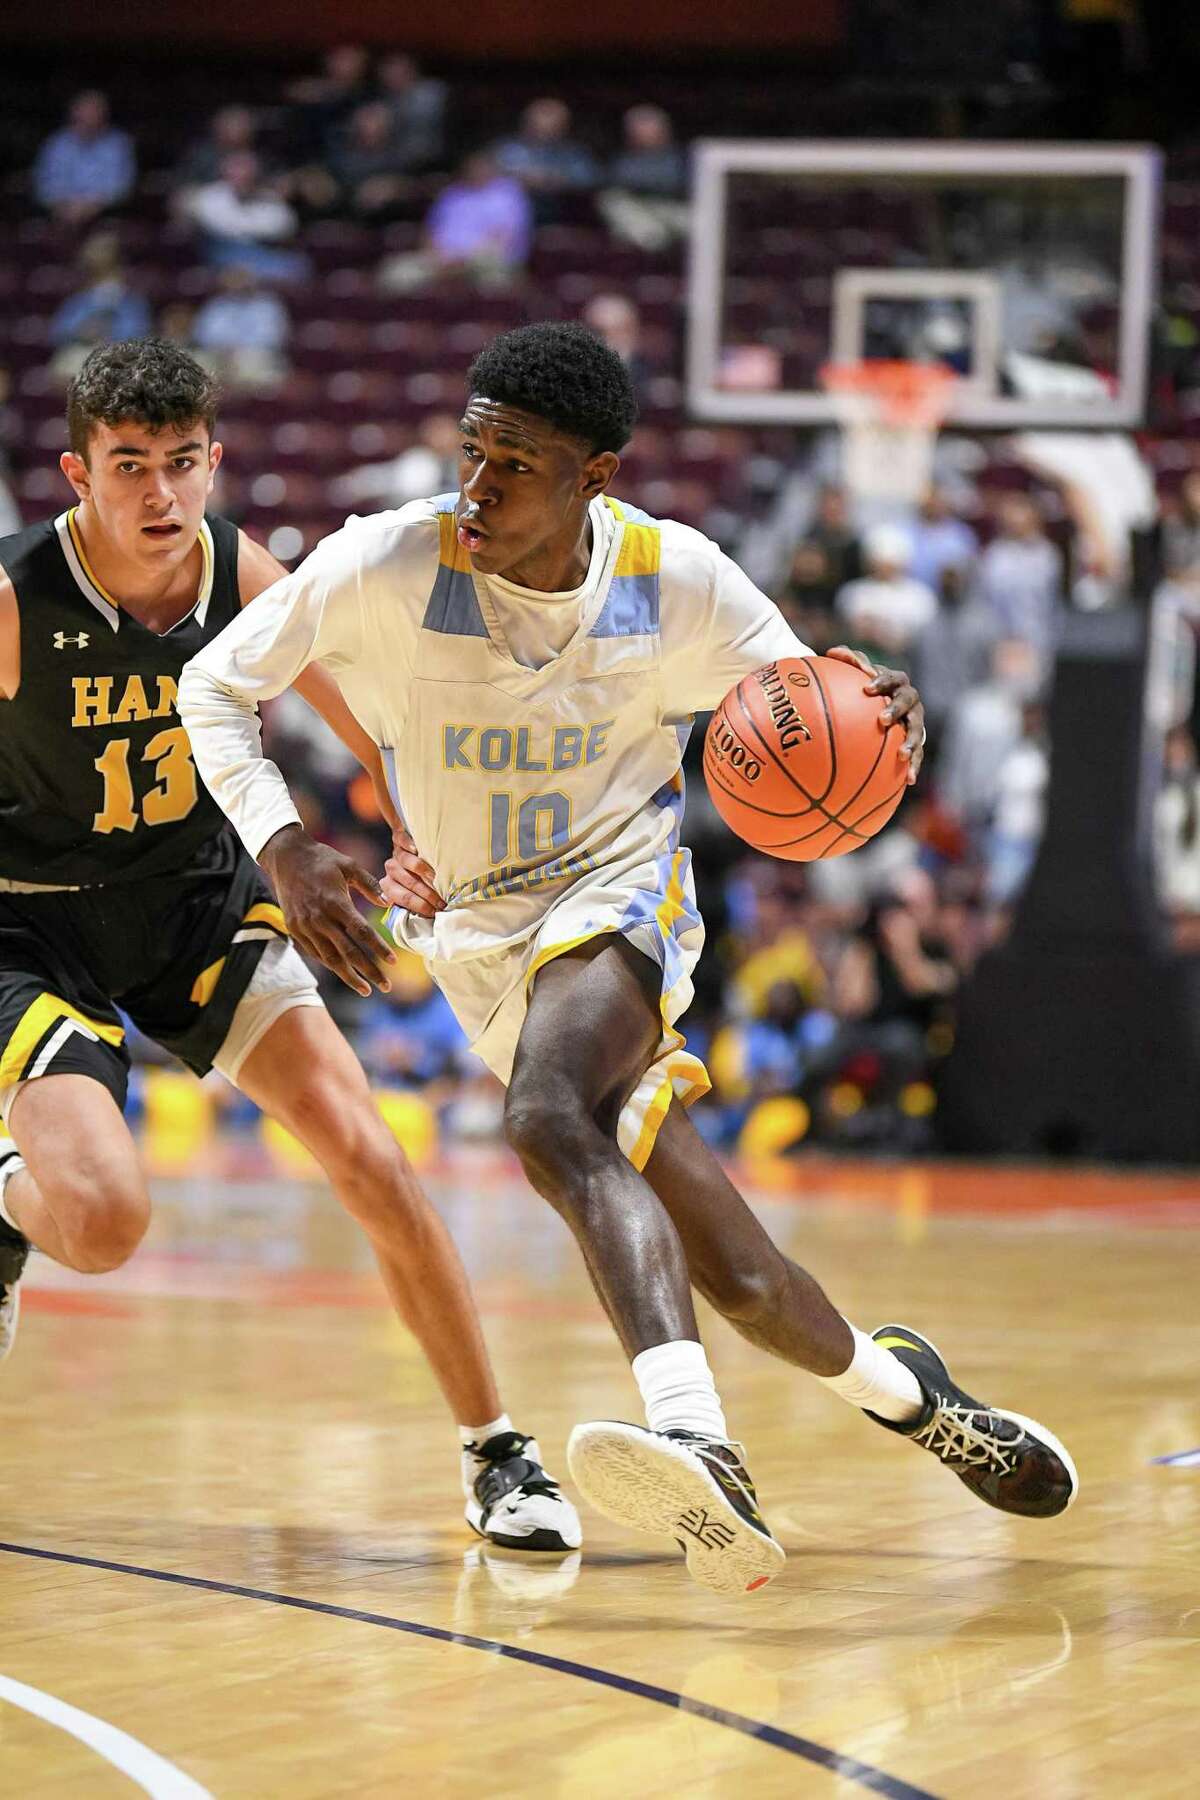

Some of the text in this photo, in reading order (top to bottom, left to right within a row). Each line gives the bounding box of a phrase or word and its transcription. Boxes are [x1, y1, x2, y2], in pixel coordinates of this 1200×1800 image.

[92, 726, 199, 835] 13
[443, 717, 616, 773] KOLBE
[488, 790, 574, 867] 10
